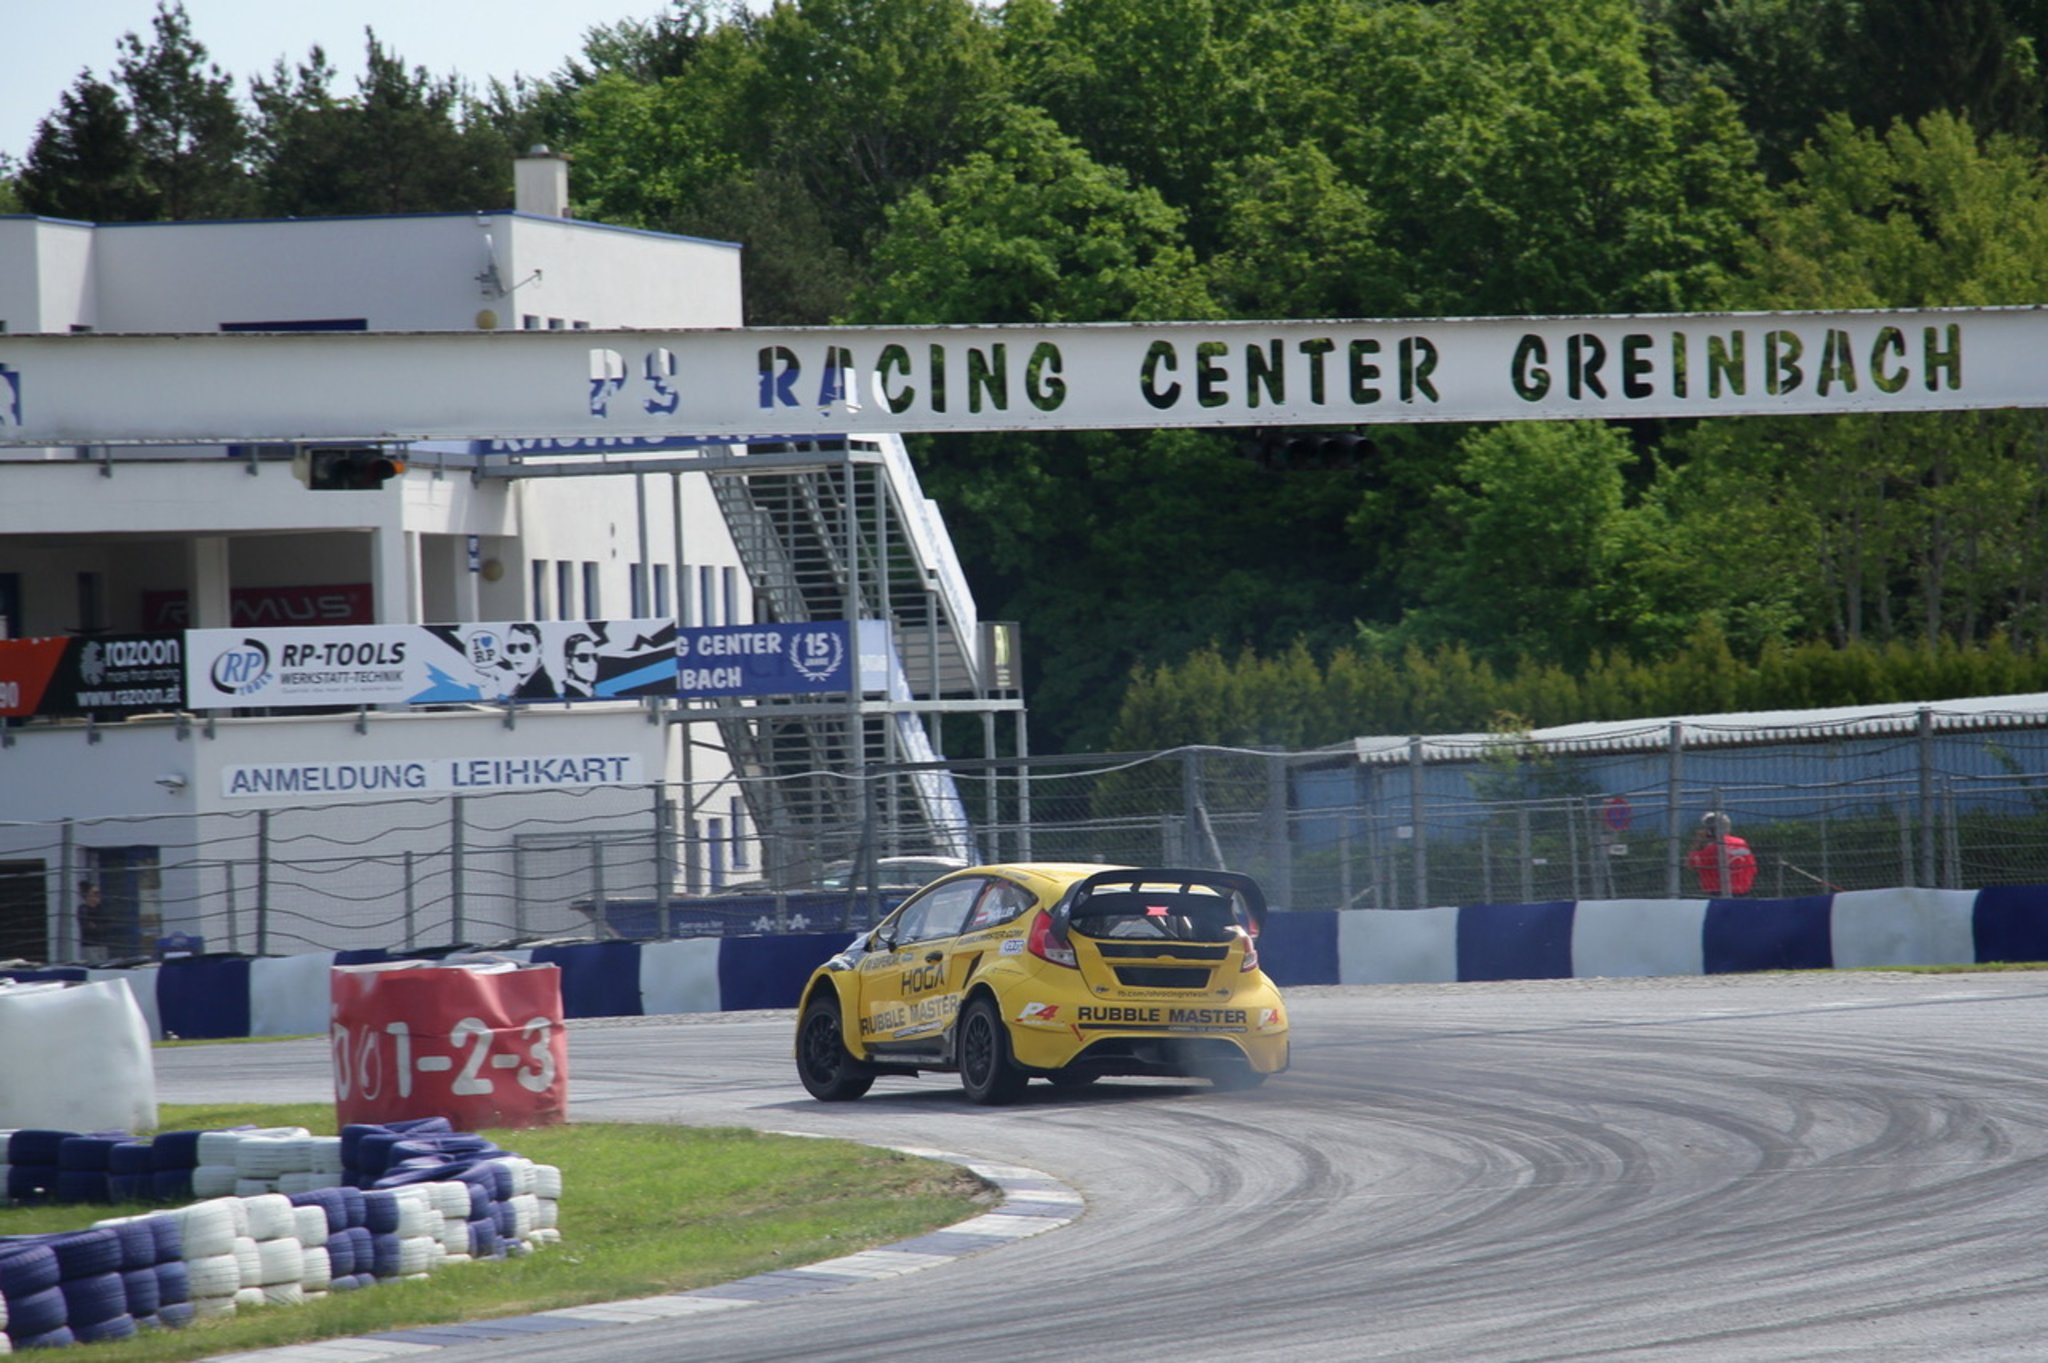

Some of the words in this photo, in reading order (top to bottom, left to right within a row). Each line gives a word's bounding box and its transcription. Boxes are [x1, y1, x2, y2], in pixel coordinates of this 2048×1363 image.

[590, 347, 680, 418] PS
[758, 341, 1067, 416] RACING
[1140, 336, 1439, 410] CENTER
[1510, 323, 1962, 402] GREINBACH
[157, 595, 353, 623] RMUS
[104, 639, 180, 667] razoon
[281, 642, 406, 667] RP-TOOLS
[697, 632, 782, 656] CENTER
[805, 632, 829, 656] 15
[222, 651, 263, 682] RP
[280, 670, 404, 685] WERKSTATT-TECHNIK
[676, 666, 741, 690] BACH
[77, 684, 181, 706] www.razoon.at
[230, 763, 425, 794] ANMELDUNG
[451, 757, 630, 787] LEIHKART
[860, 1006, 906, 1036] RUBBLE
[910, 994, 961, 1023] MASTER
[1077, 1006, 1160, 1022] RUBBLE
[1168, 1008, 1247, 1024] MASTER
